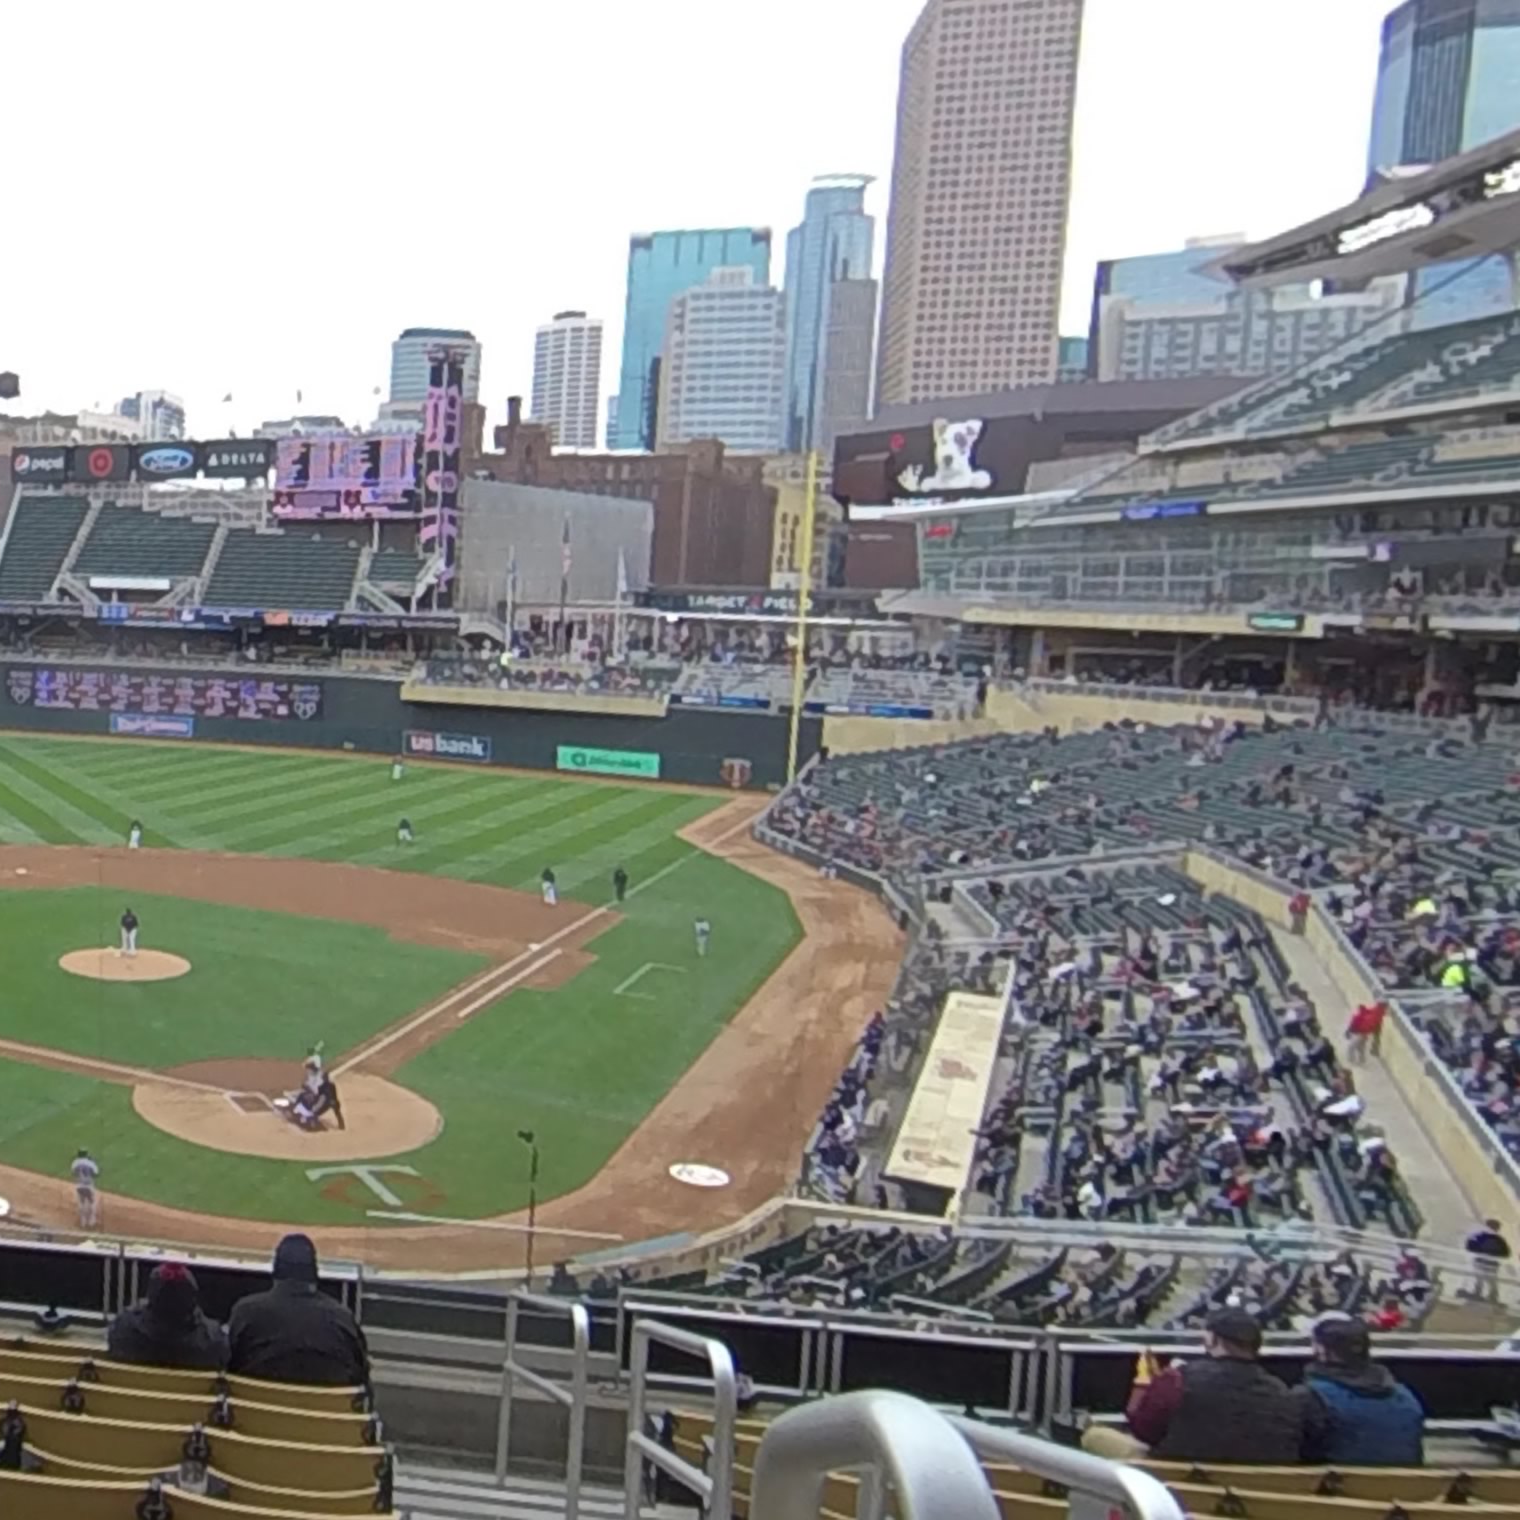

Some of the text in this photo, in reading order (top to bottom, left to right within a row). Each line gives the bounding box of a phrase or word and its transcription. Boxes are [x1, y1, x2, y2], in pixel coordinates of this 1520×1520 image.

[30, 456, 64, 473] pepsi
[221, 452, 265, 466] DELTA
[687, 595, 747, 609] TARGET
